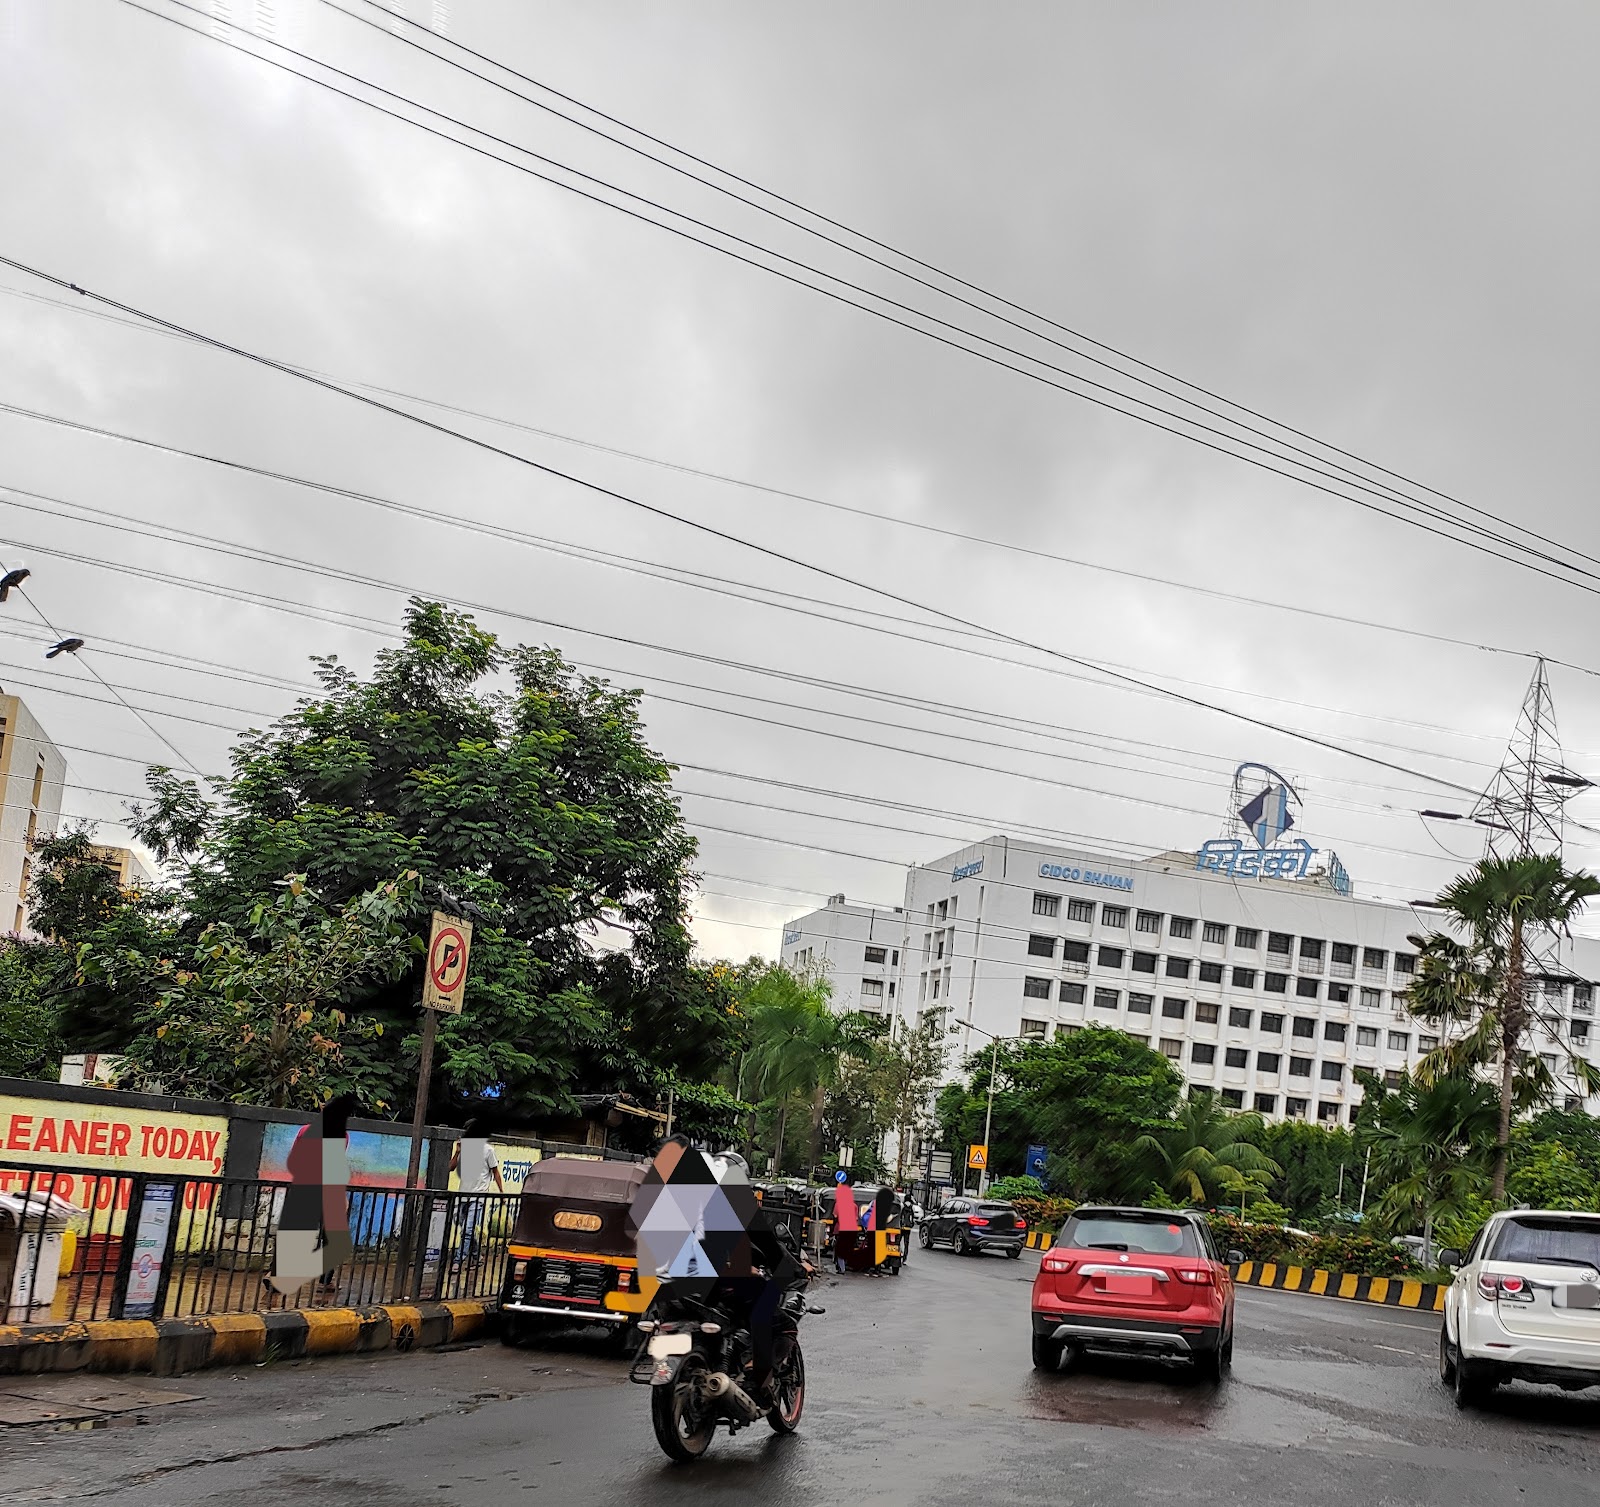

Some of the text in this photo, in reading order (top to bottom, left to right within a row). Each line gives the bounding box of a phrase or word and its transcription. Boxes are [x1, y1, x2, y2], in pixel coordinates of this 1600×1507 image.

[1040, 863, 1134, 891] CIDCO BHAVAN
[0, 1115, 222, 1175] EANER TODAY,
